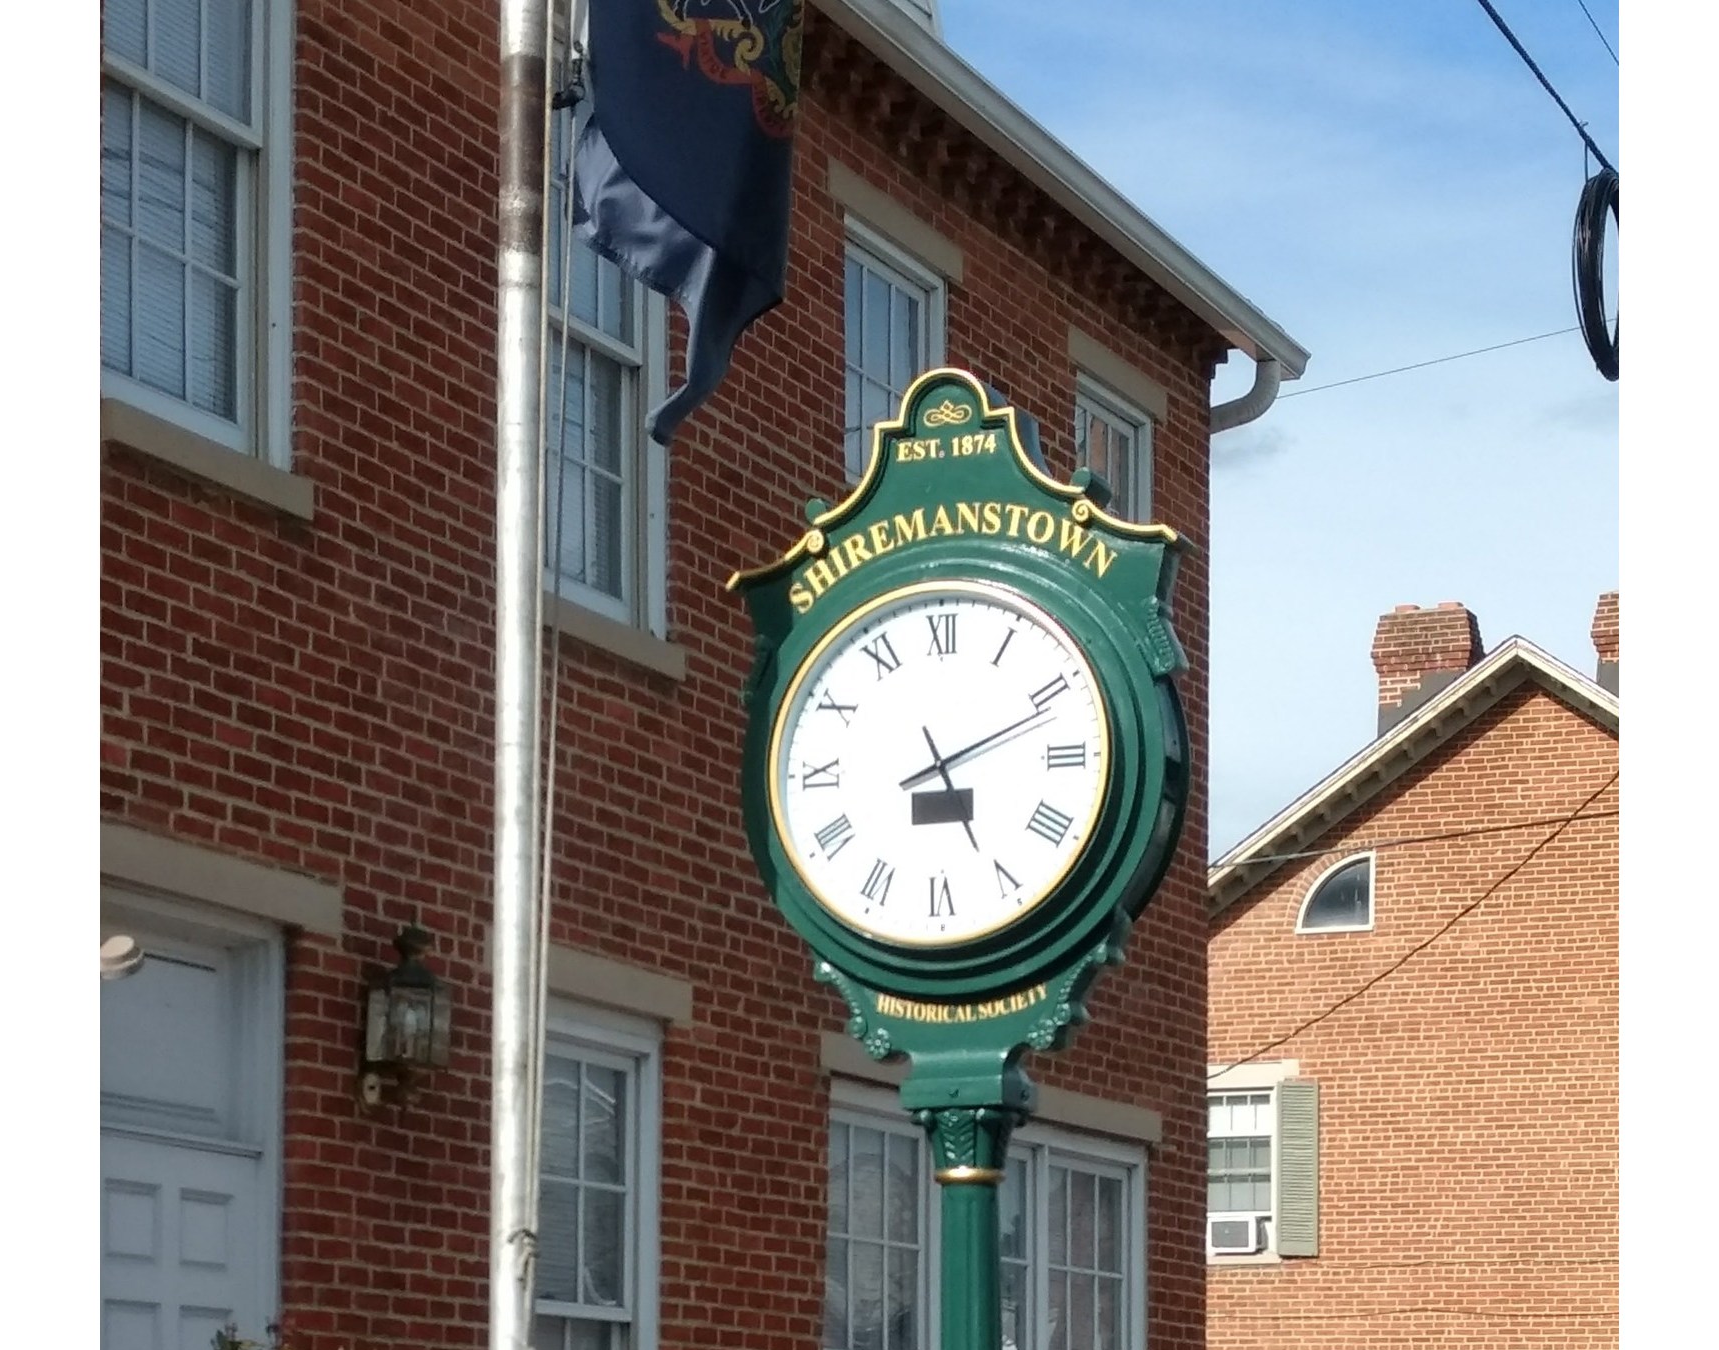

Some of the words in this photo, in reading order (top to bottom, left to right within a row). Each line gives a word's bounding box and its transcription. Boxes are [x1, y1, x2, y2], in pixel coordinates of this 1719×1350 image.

[896, 439, 945, 462] EST.
[951, 433, 997, 457] 1874
[788, 501, 1118, 614] SHIREMANSTOWN
[925, 613, 958, 656] XII
[990, 627, 1017, 667] I
[861, 632, 903, 681] XI
[816, 688, 859, 727] X
[1028, 672, 1071, 713] II
[802, 758, 840, 791] IX
[1046, 741, 1086, 771] III
[813, 813, 856, 861] VIII
[1025, 799, 1074, 848] IIII
[860, 858, 896, 907] VII
[928, 876, 957, 918] VI
[993, 859, 1024, 900] V
[876, 992, 978, 1023] HISTORICAL
[978, 982, 1048, 1019] SOCIETY
